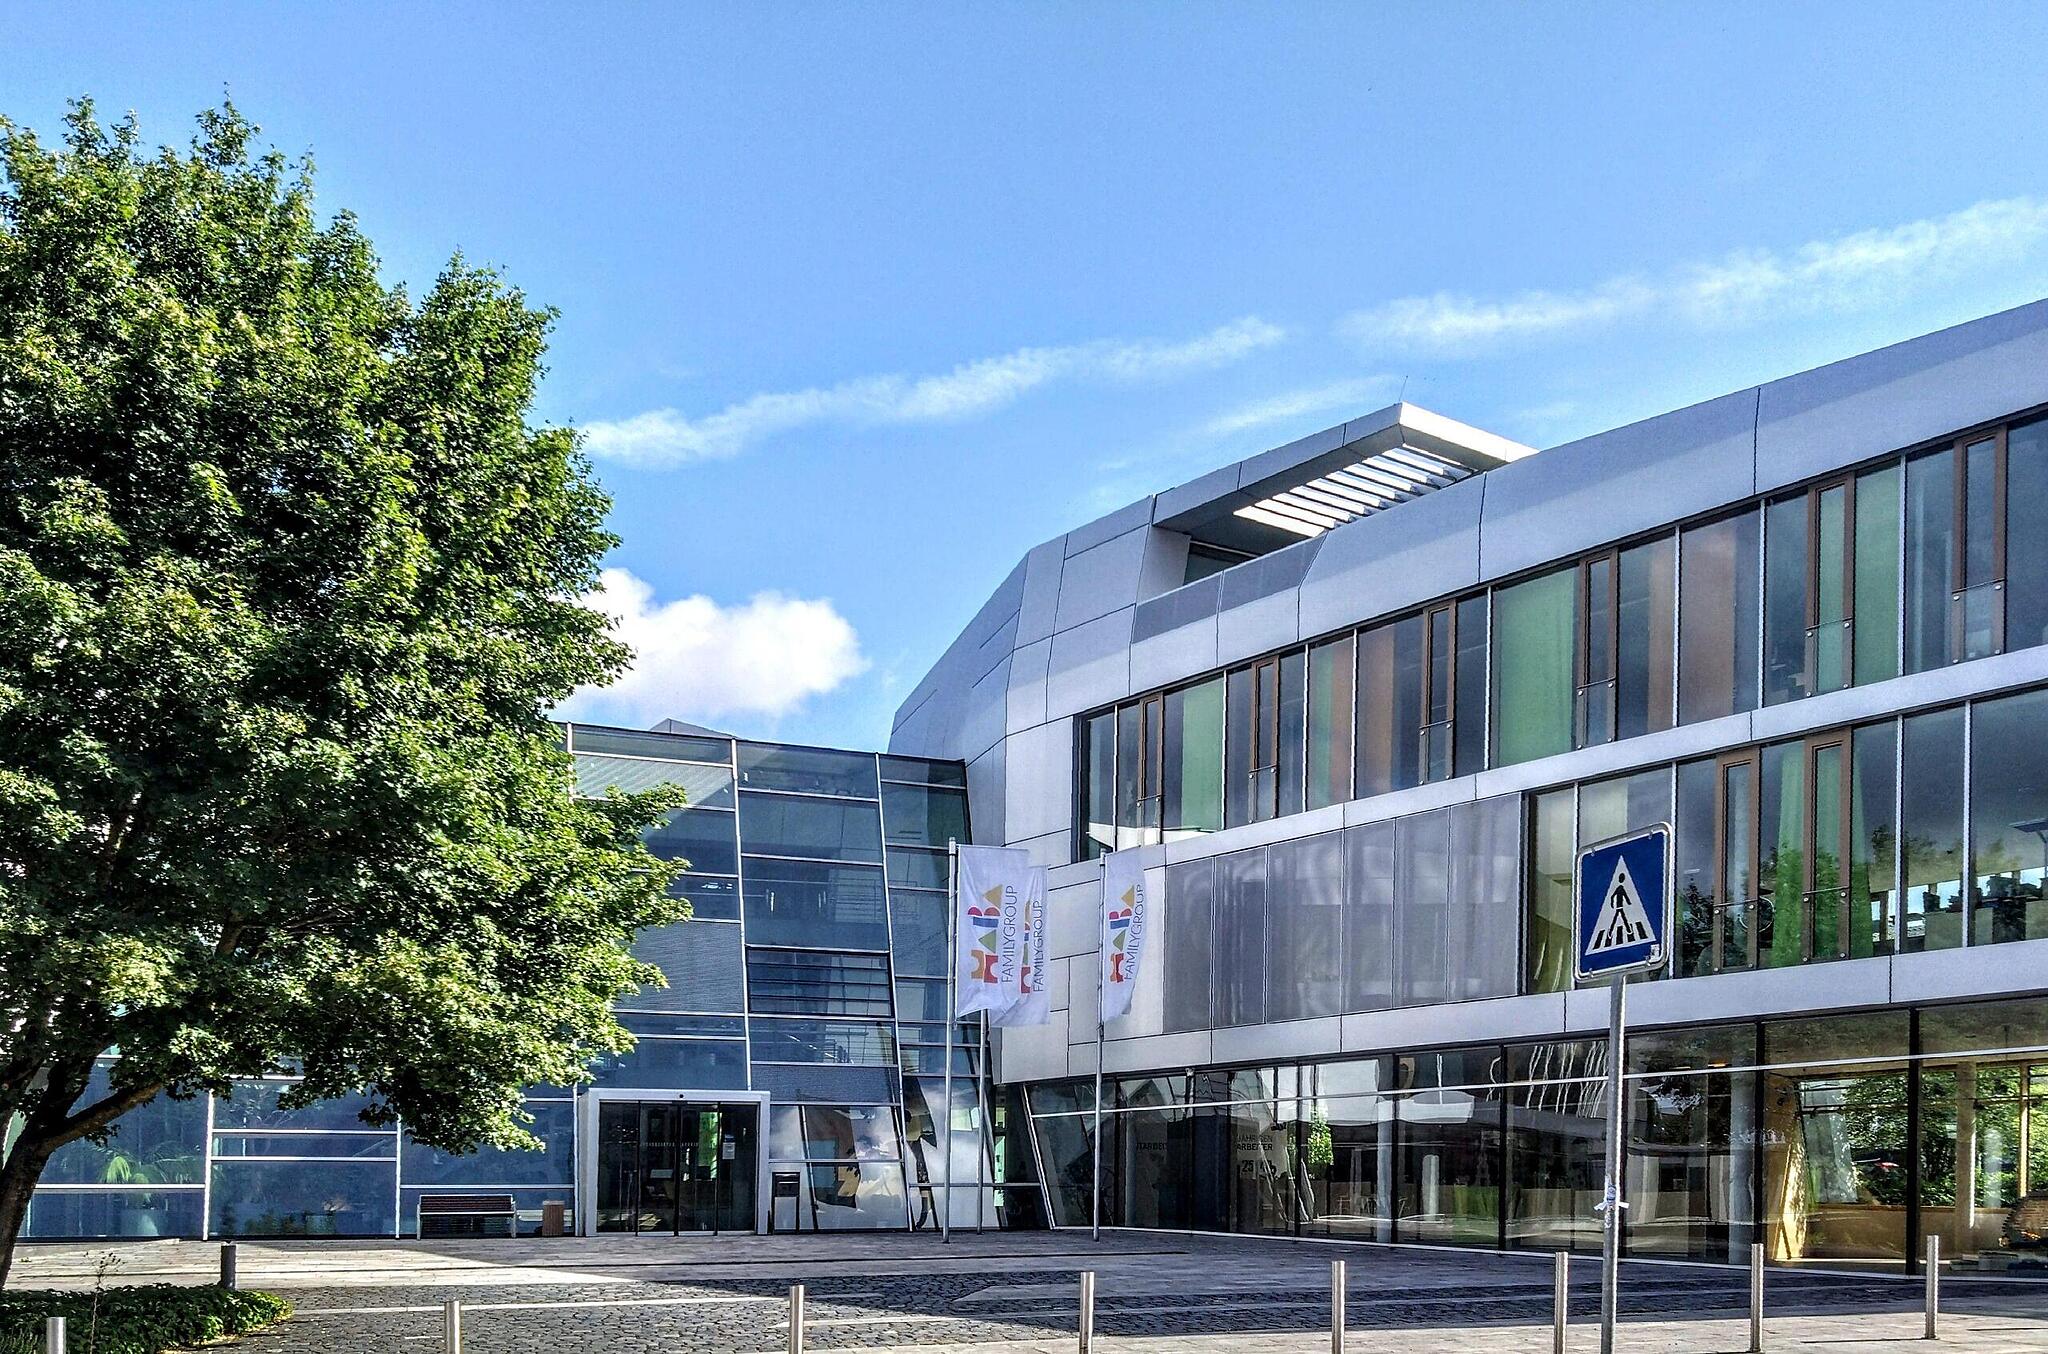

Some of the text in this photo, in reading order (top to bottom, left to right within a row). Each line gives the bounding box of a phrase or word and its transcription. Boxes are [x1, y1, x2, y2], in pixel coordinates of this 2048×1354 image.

[1001, 885, 1019, 983] FAMILYGROUP
[1032, 900, 1044, 992] FAMILYGROUP
[1124, 884, 1145, 981] FAMILYGROUP
